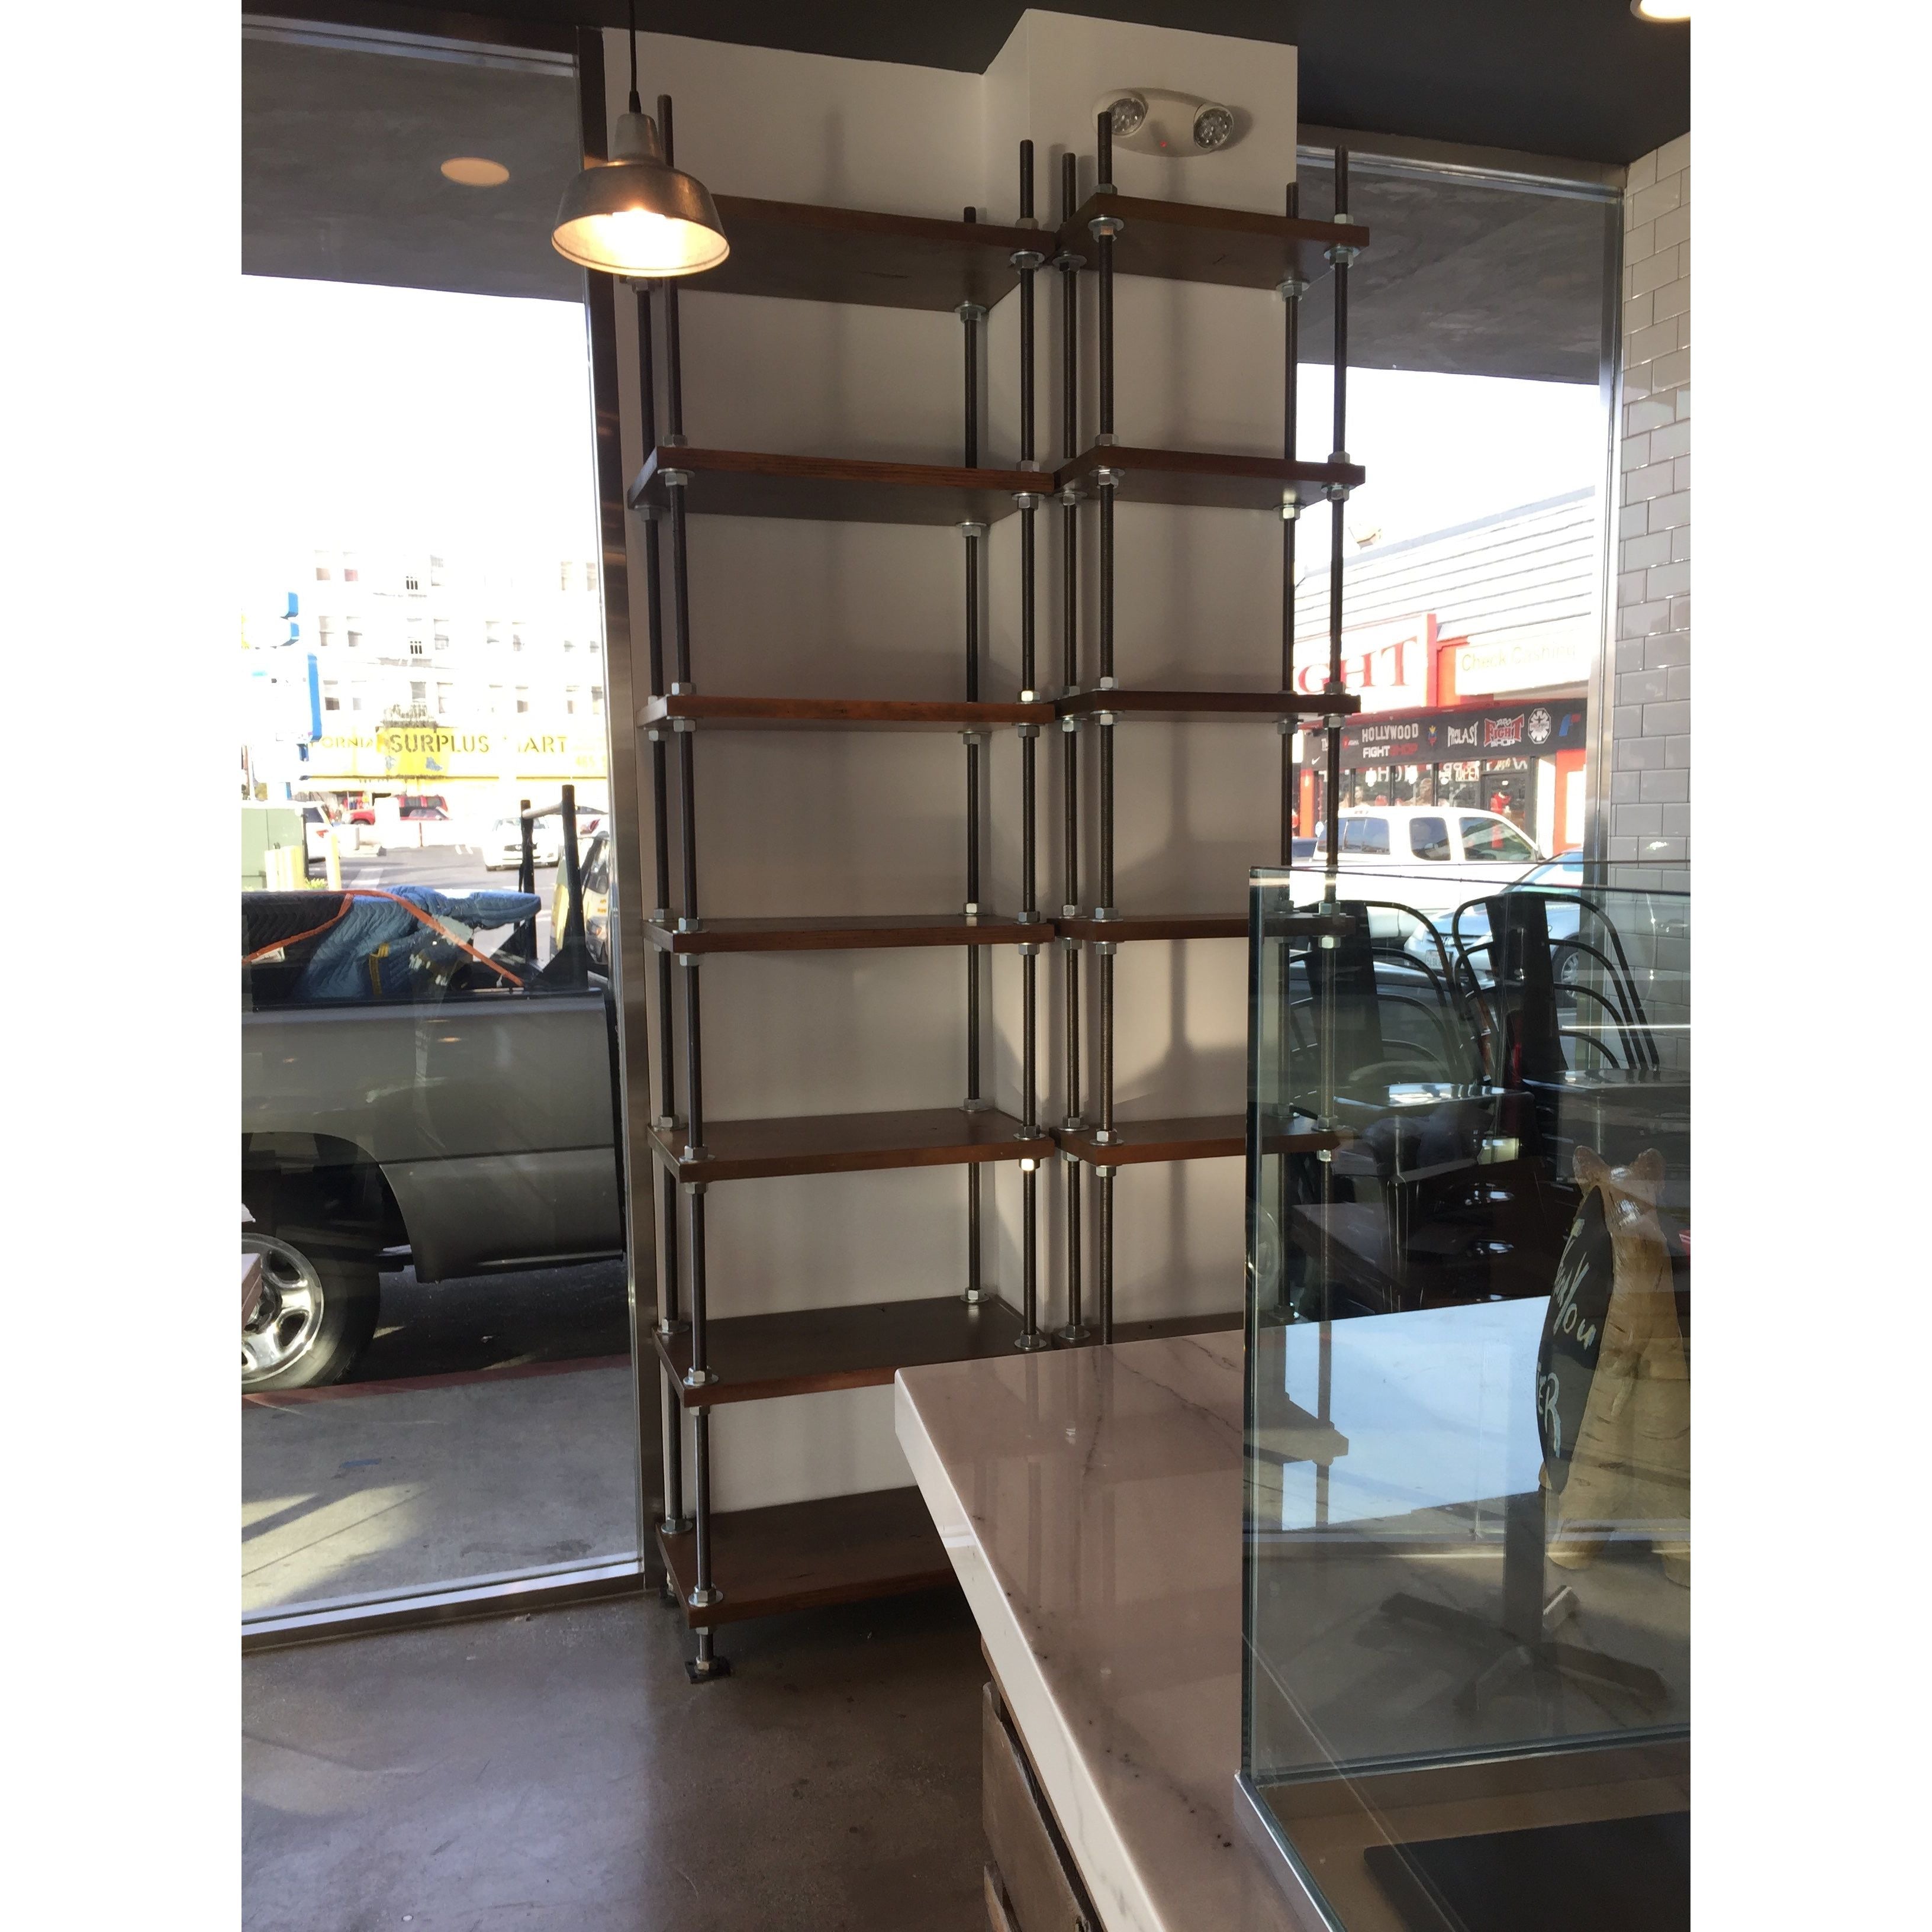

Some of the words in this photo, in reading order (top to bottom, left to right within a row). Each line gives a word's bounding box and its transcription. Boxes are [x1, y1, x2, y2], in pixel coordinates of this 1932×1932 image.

[1462, 649, 1506, 671] Check
[1362, 723, 1419, 742] HOLLYWOOD
[389, 734, 490, 753] SURPLUS
[505, 736, 566, 752] ART
[1363, 745, 1390, 758] FIGHT
[1553, 1251, 1596, 1351] You
